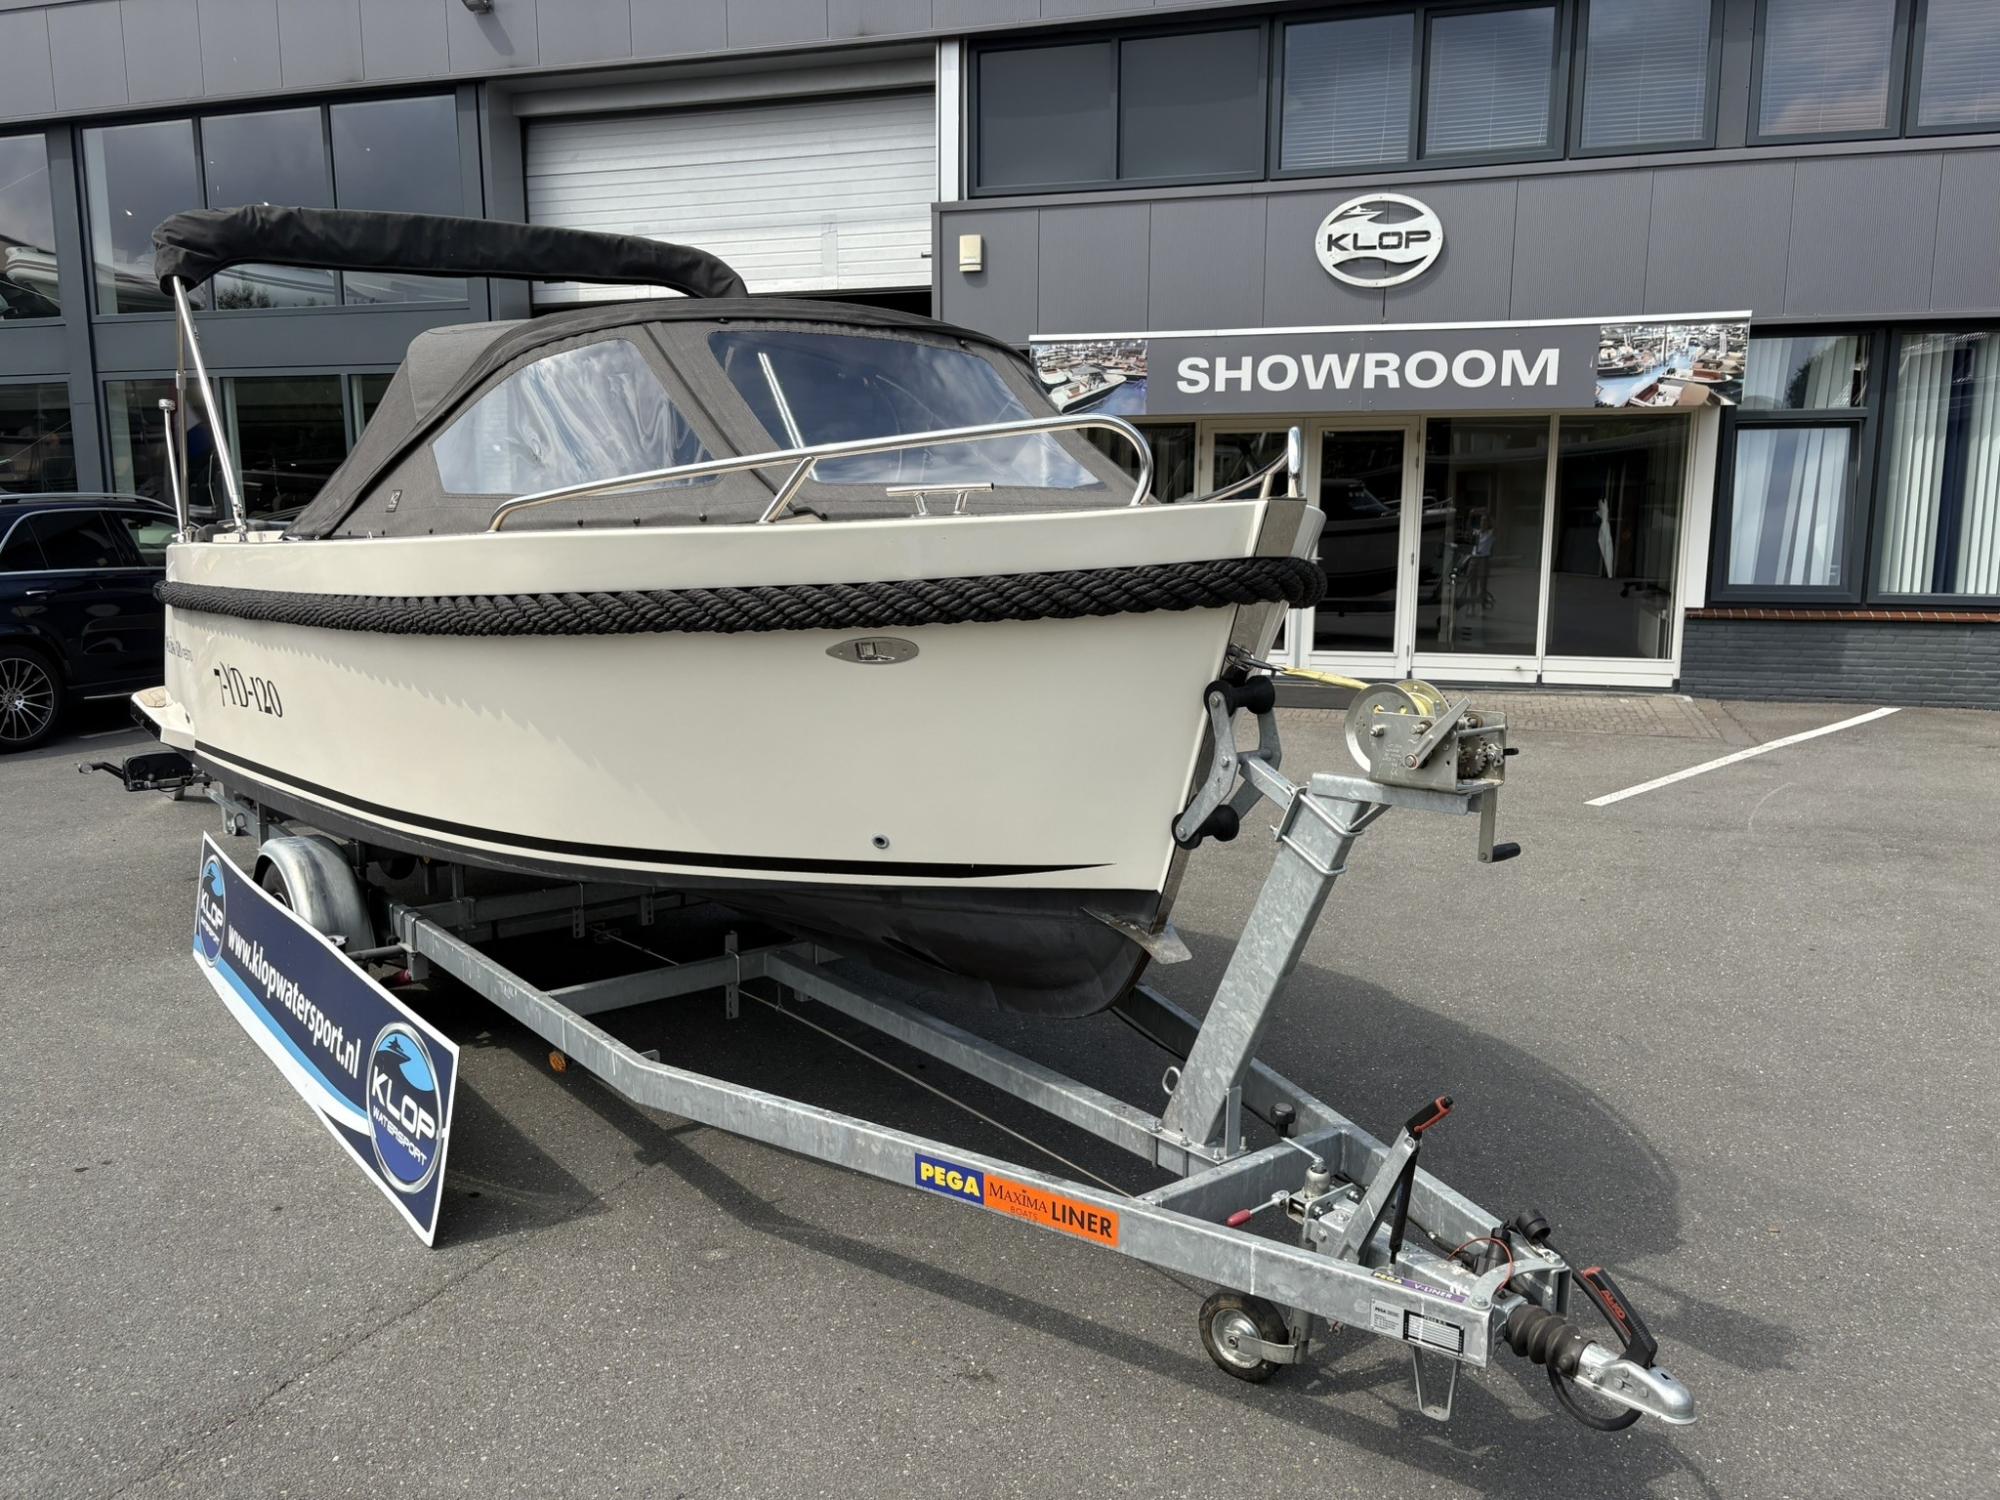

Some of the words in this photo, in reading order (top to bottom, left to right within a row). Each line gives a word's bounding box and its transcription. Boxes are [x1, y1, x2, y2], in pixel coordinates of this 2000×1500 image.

[1327, 230, 1431, 252] KLOP
[1176, 348, 1559, 394] SHOWROOM
[200, 888, 223, 930] KLOP
[227, 924, 361, 1079] www.klopwatersport.nl
[371, 1066, 435, 1140] KLOP
[372, 1105, 428, 1166] WATERSPORT
[920, 1161, 981, 1197] PEGA
[1051, 1201, 1112, 1239] LINER
[1414, 1283, 1453, 1299] V-LINER
